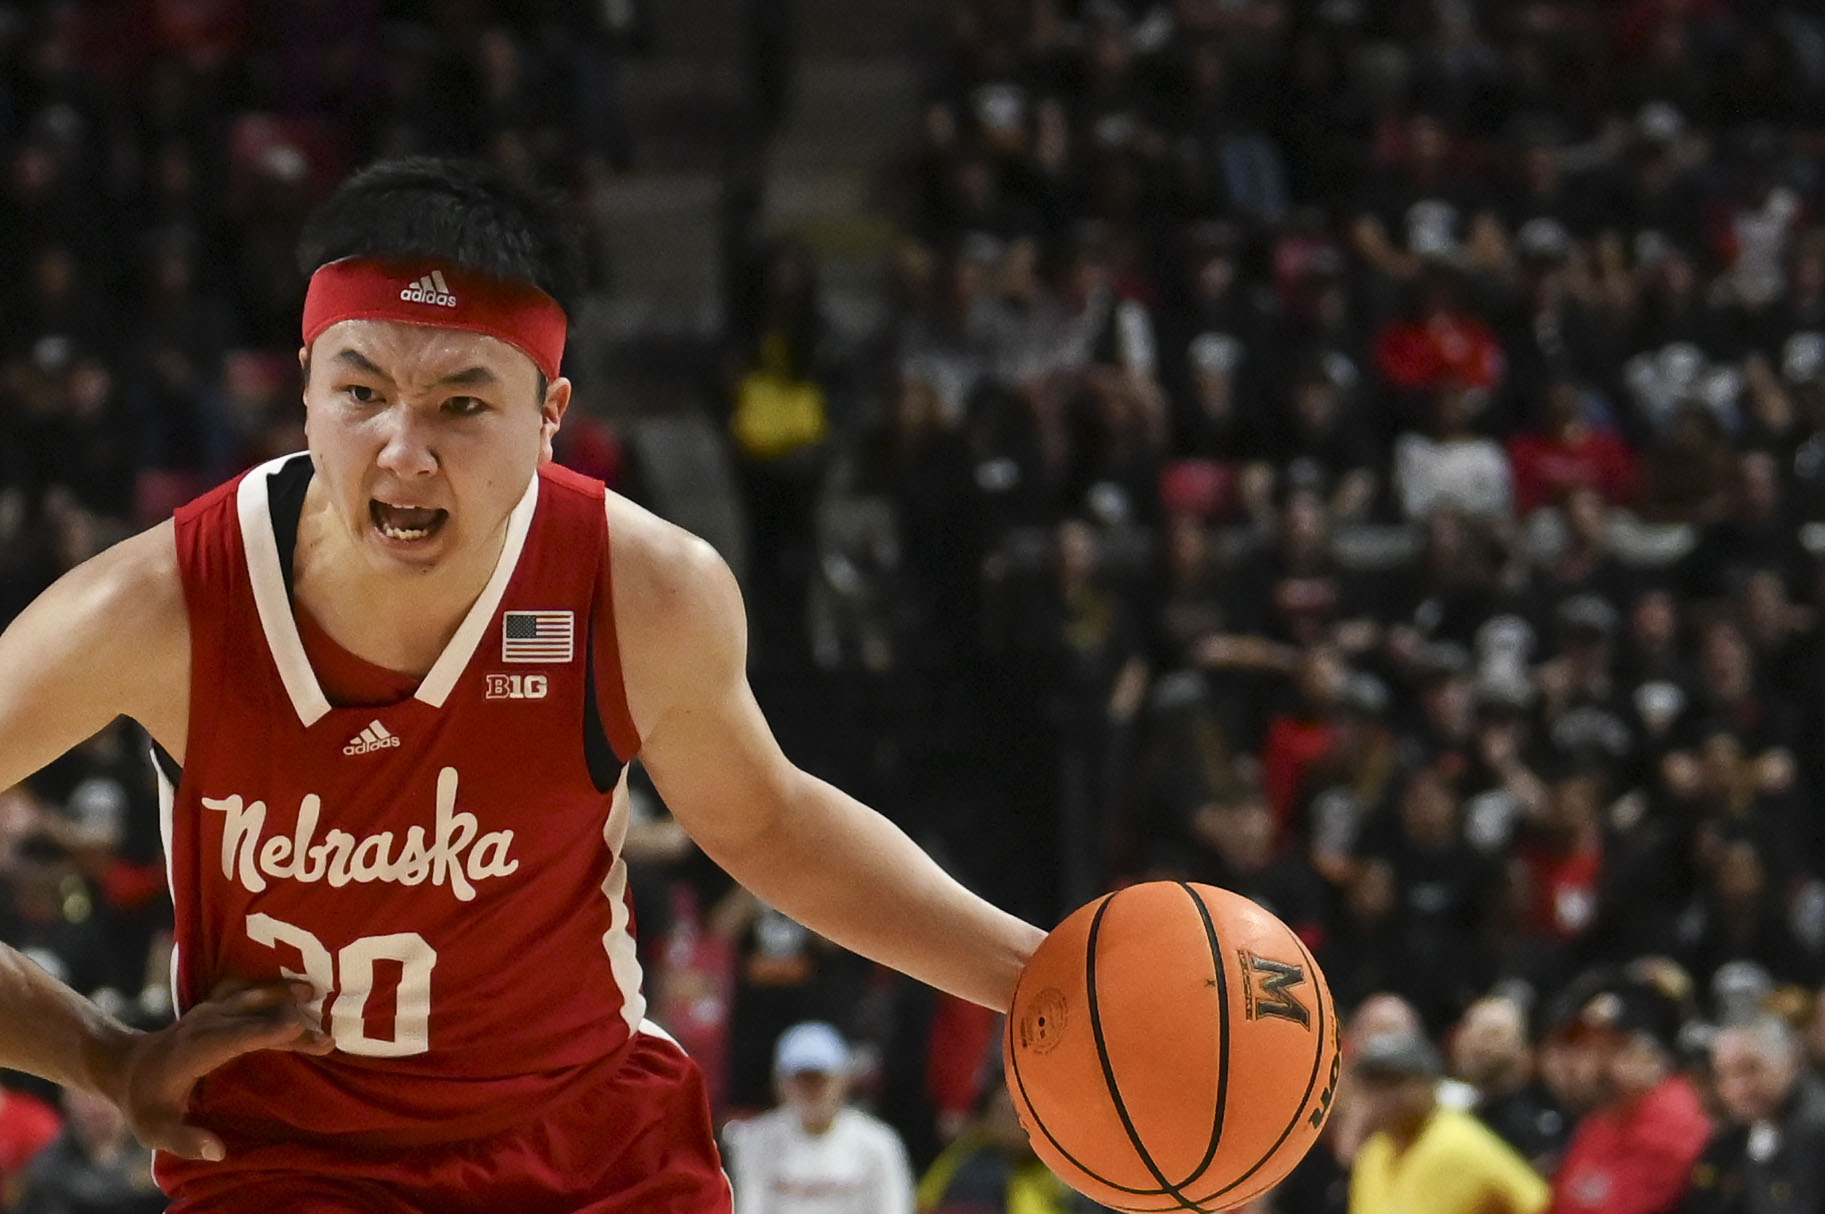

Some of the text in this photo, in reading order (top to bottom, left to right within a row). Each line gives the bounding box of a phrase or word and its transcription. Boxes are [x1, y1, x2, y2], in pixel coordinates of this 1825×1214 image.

[400, 288, 457, 308] adidas
[342, 735, 401, 756] adidas
[201, 766, 519, 901] Nebraska
[1247, 950, 1312, 1032] M
